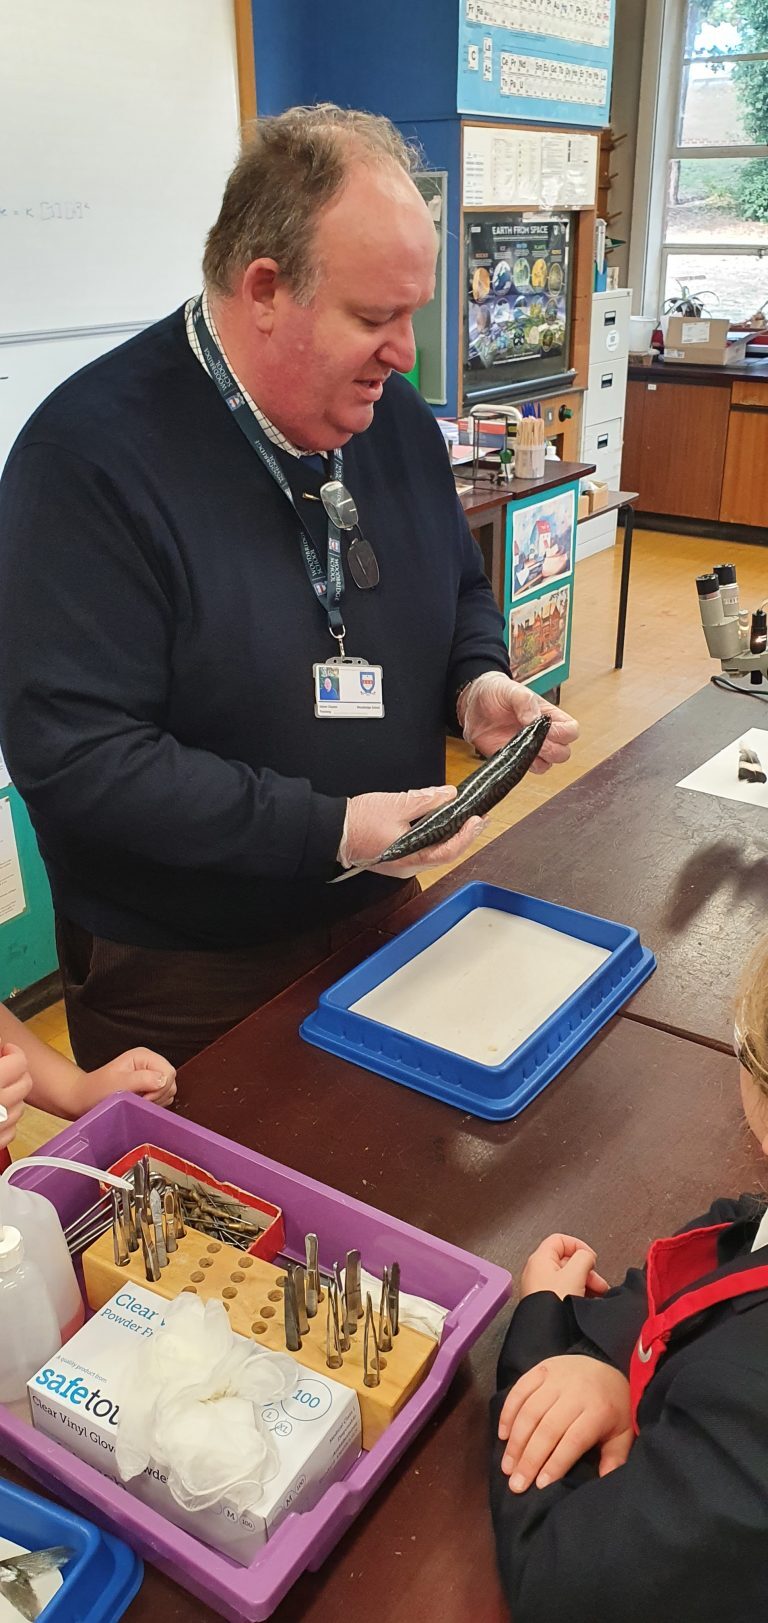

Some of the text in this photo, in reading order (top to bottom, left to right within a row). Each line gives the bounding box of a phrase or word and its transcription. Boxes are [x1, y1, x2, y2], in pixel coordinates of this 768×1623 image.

[492, 225, 549, 235] EARTH FROM SPACE
[204, 347, 228, 391] WOODBRIDGE
[215, 359, 232, 387] SCHOOL
[115, 1293, 160, 1321] Clear
[100, 1308, 142, 1333] Powder
[60, 1356, 77, 1369] quality
[75, 1363, 97, 1377] product
[292, 1389, 321, 1409] 100
[32, 1395, 116, 1454] Clear Vinyl Glov
